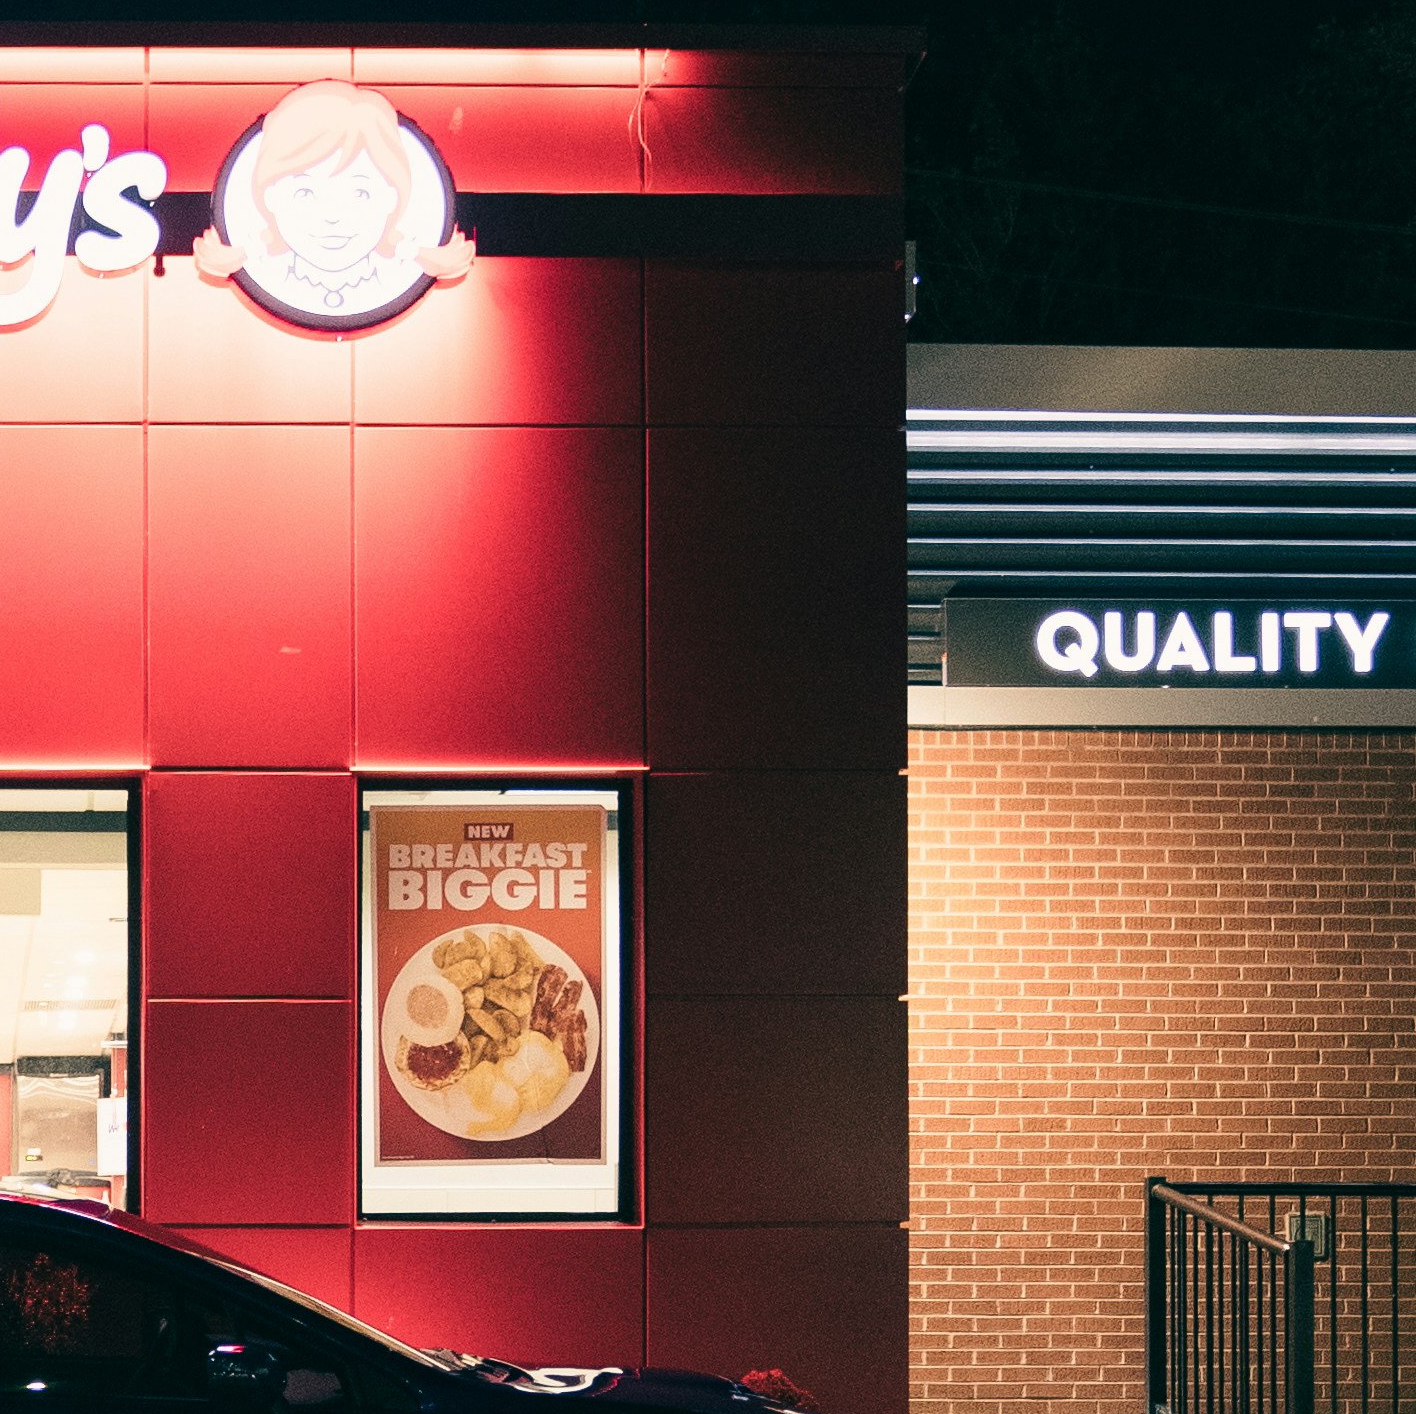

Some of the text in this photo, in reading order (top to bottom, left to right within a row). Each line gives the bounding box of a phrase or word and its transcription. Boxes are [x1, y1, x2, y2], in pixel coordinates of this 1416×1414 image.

[1036, 610, 1390, 678] QUALITY
[467, 824, 510, 839] NEW
[388, 842, 588, 869] BREAKFAST
[388, 868, 588, 910] BIGGIE
